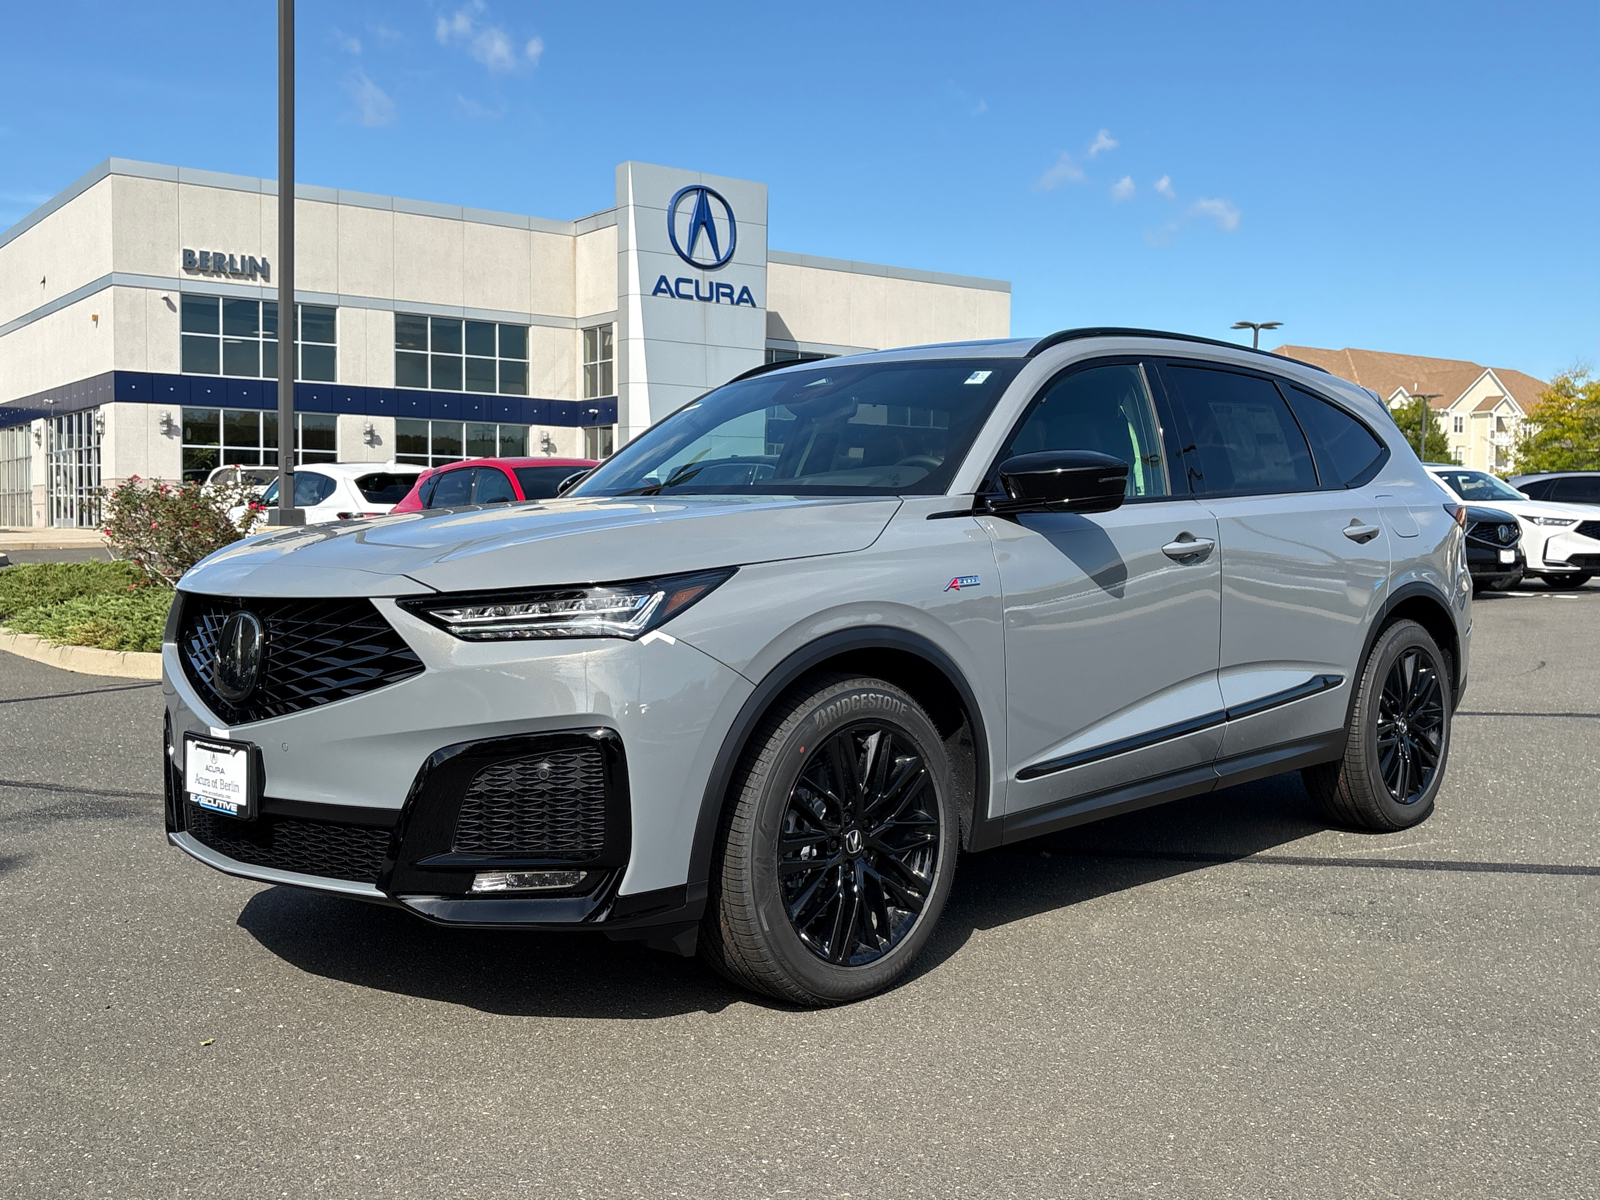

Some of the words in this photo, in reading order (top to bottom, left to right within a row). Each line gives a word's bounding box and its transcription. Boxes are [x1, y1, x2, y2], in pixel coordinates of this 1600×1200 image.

[182, 248, 268, 279] BERLIN
[652, 275, 757, 308] ACURA
[813, 693, 908, 732] BRIDGESTONE
[205, 765, 225, 775] ACURA
[195, 773, 211, 788] Acura
[219, 779, 240, 793] Berlin
[190, 792, 238, 812] EXECUTIVE
